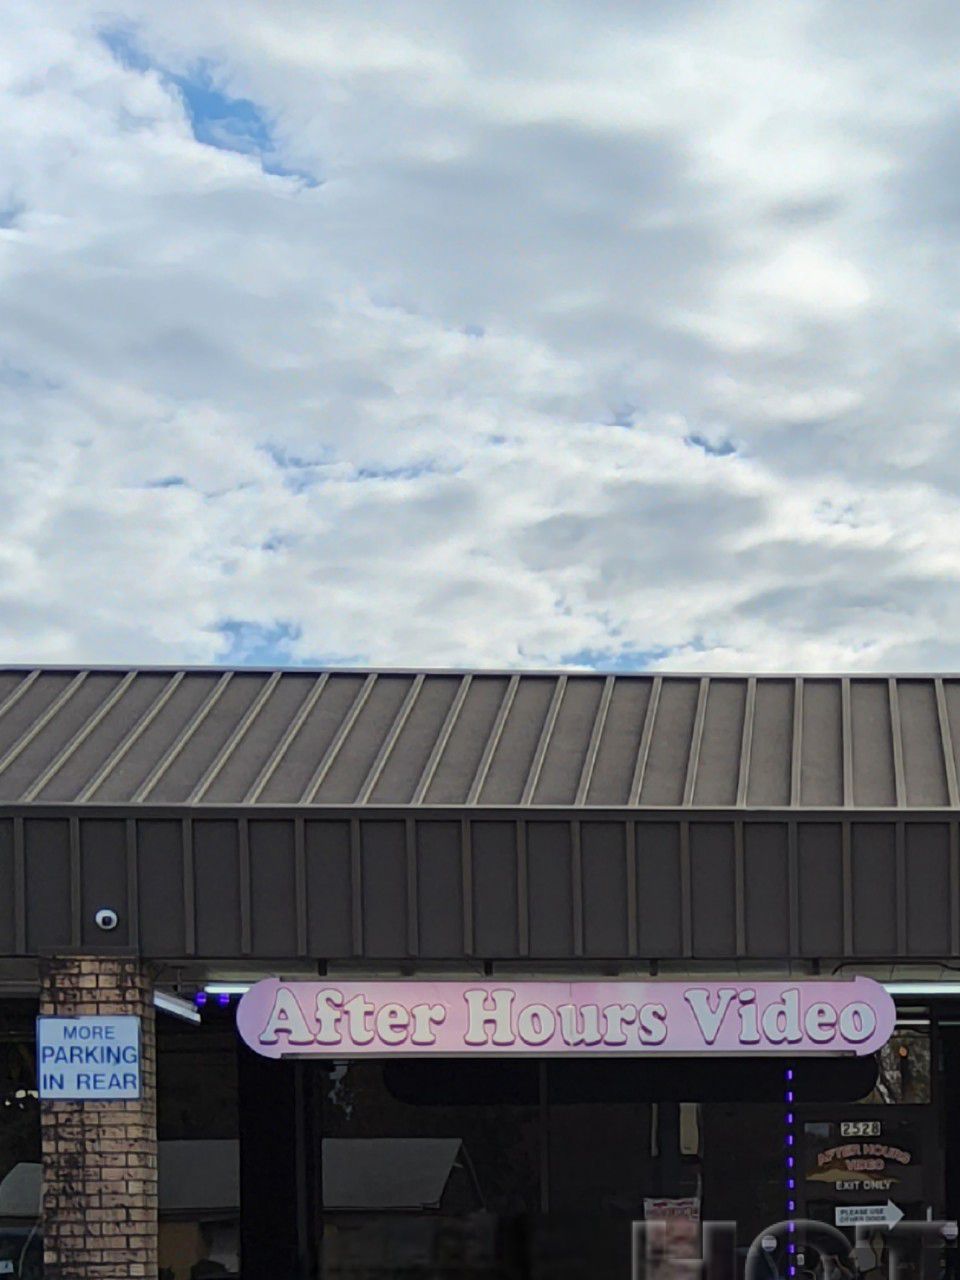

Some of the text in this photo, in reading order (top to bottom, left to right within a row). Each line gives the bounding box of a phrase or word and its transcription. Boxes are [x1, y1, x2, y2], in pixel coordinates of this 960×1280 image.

[258, 986, 878, 1047] After Hours Video
[63, 1025, 116, 1040] MORE
[41, 1045, 138, 1065] PARKING
[43, 1073, 138, 1090] IN REAR
[842, 1122, 881, 1136] 2528
[835, 1180, 892, 1191] EXIT ONLY
[840, 1207, 868, 1215] PLEASE
